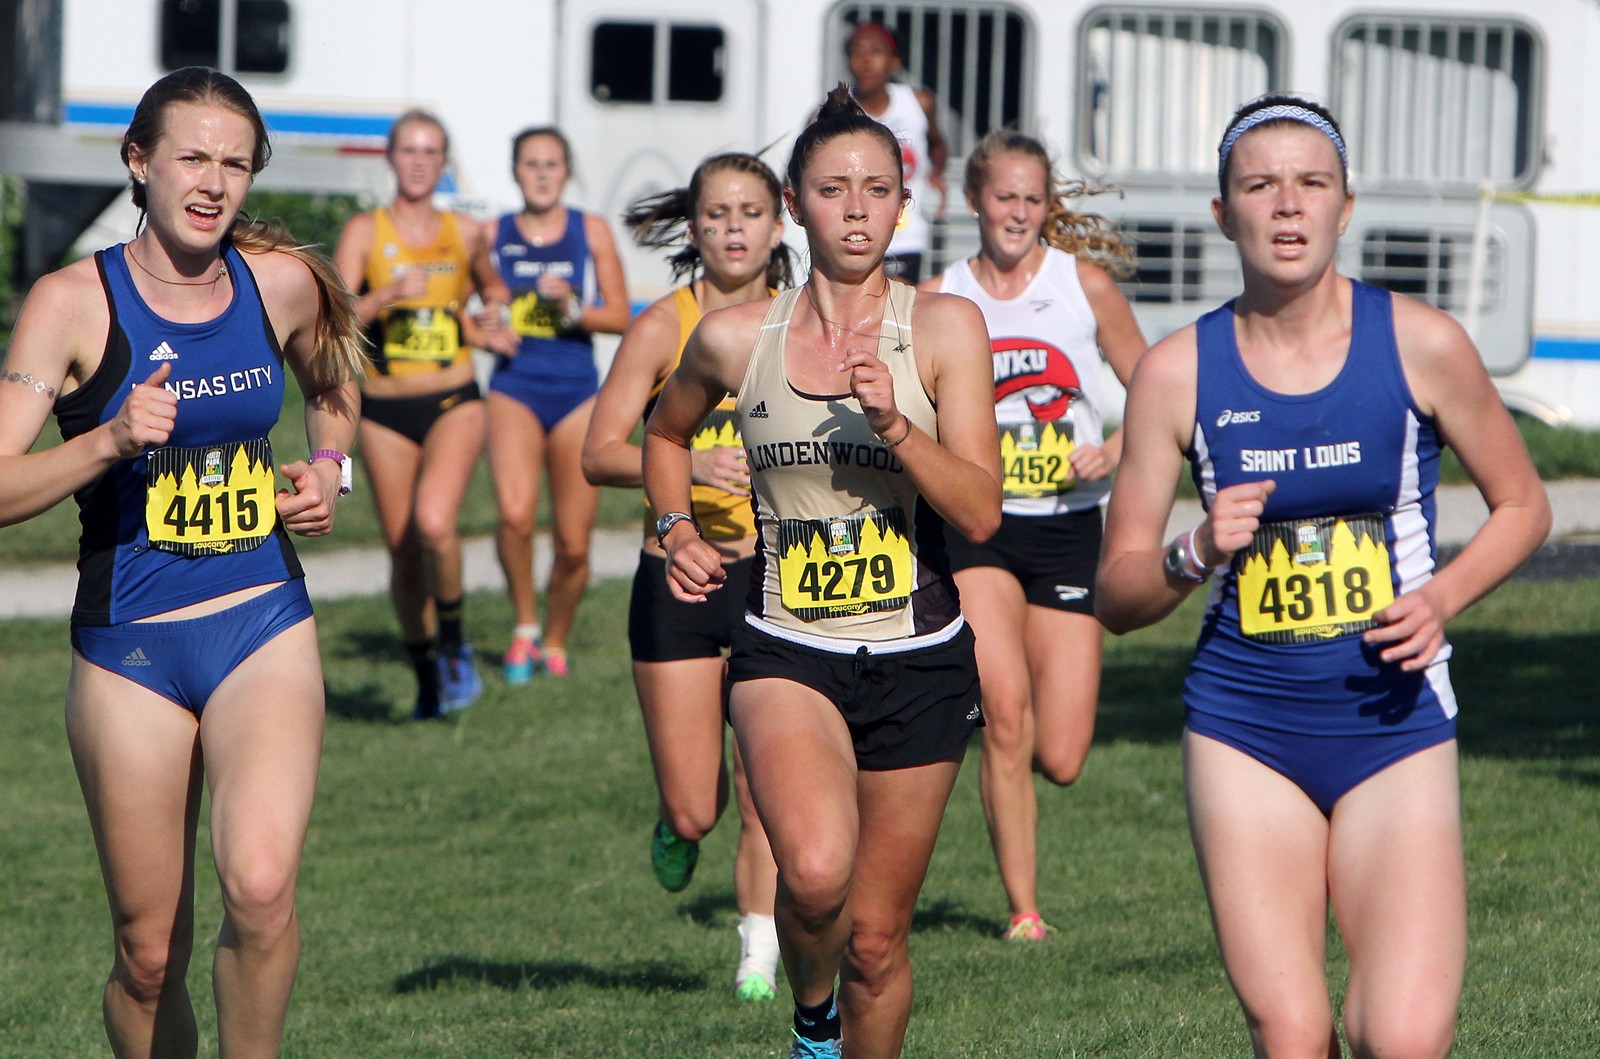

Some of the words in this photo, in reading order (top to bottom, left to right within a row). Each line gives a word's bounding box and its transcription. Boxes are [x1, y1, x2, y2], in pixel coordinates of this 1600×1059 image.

[149, 352, 179, 361] adidas
[993, 348, 1048, 381] WKU
[131, 375, 227, 401] NSAS
[230, 365, 273, 392] CITY
[1230, 410, 1261, 424] asics
[1002, 455, 1062, 484] 452
[1241, 448, 1297, 472] SAINT
[1304, 441, 1361, 469] LOUIS
[163, 487, 258, 537] 4415
[193, 541, 227, 550] saucony
[798, 553, 895, 602] 4279
[828, 603, 863, 613] saucony
[1258, 566, 1374, 623] 4318
[121, 659, 151, 667] adidas
